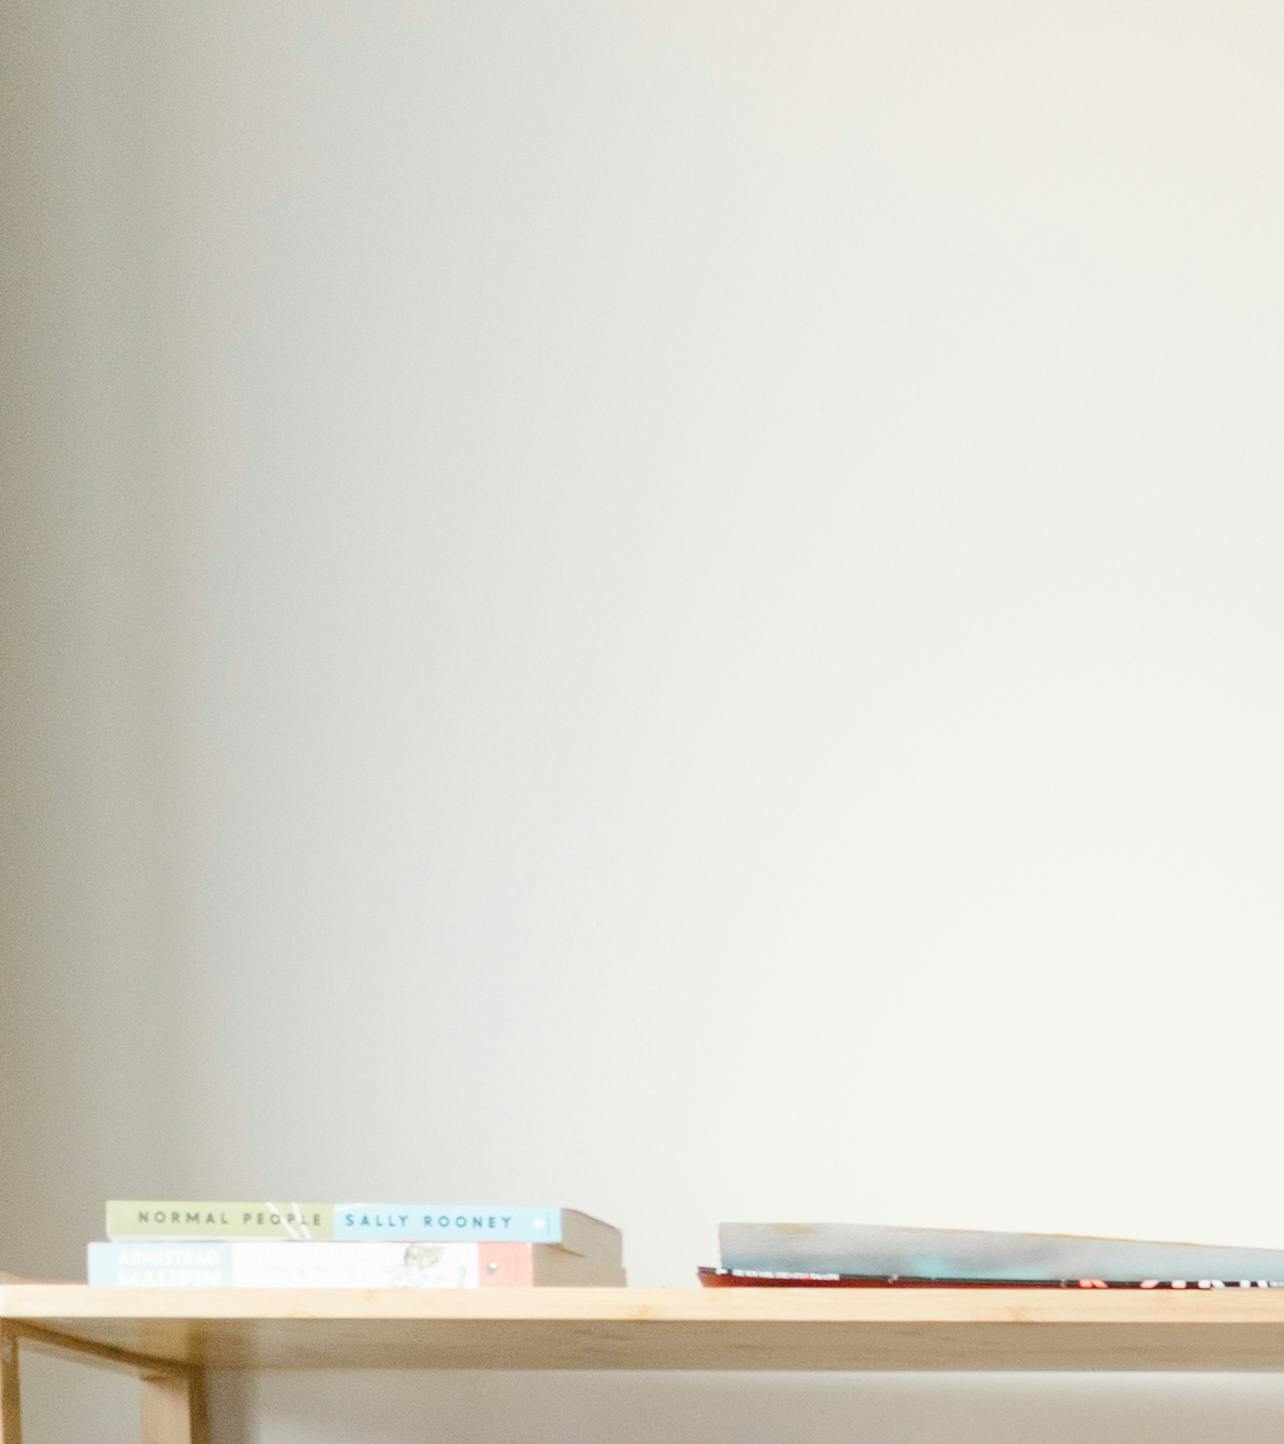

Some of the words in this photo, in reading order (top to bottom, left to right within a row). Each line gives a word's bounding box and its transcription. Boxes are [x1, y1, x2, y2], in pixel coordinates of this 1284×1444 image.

[138, 1210, 230, 1226] NORMAL
[243, 1212, 322, 1226] PEOPLE
[345, 1213, 409, 1228] SALLY
[424, 1215, 513, 1229] ROONEY
